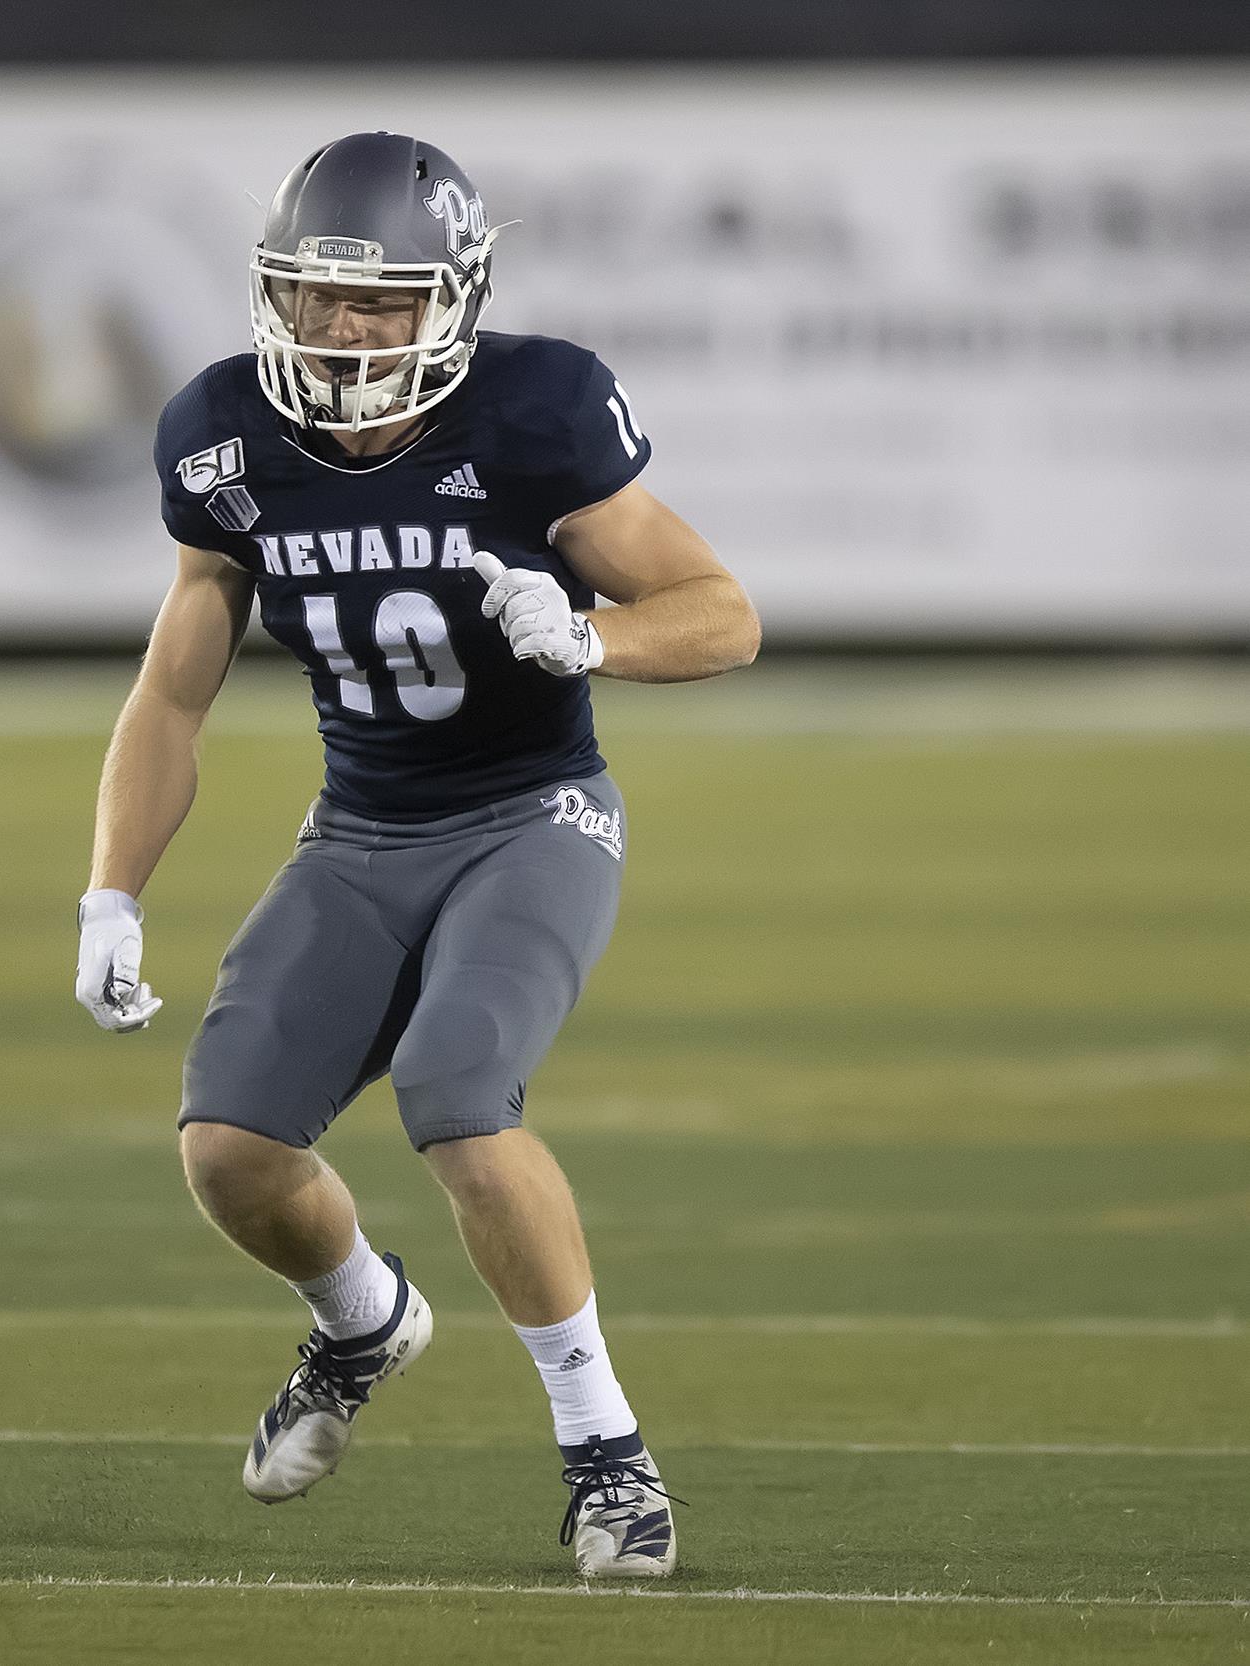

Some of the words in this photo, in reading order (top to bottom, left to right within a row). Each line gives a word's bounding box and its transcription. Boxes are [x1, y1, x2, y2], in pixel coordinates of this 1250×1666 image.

[319, 243, 362, 257] NEVADA
[177, 438, 245, 493] 150
[434, 482, 488, 499] adidas
[254, 525, 475, 576] NEVADA
[302, 588, 467, 722] 10
